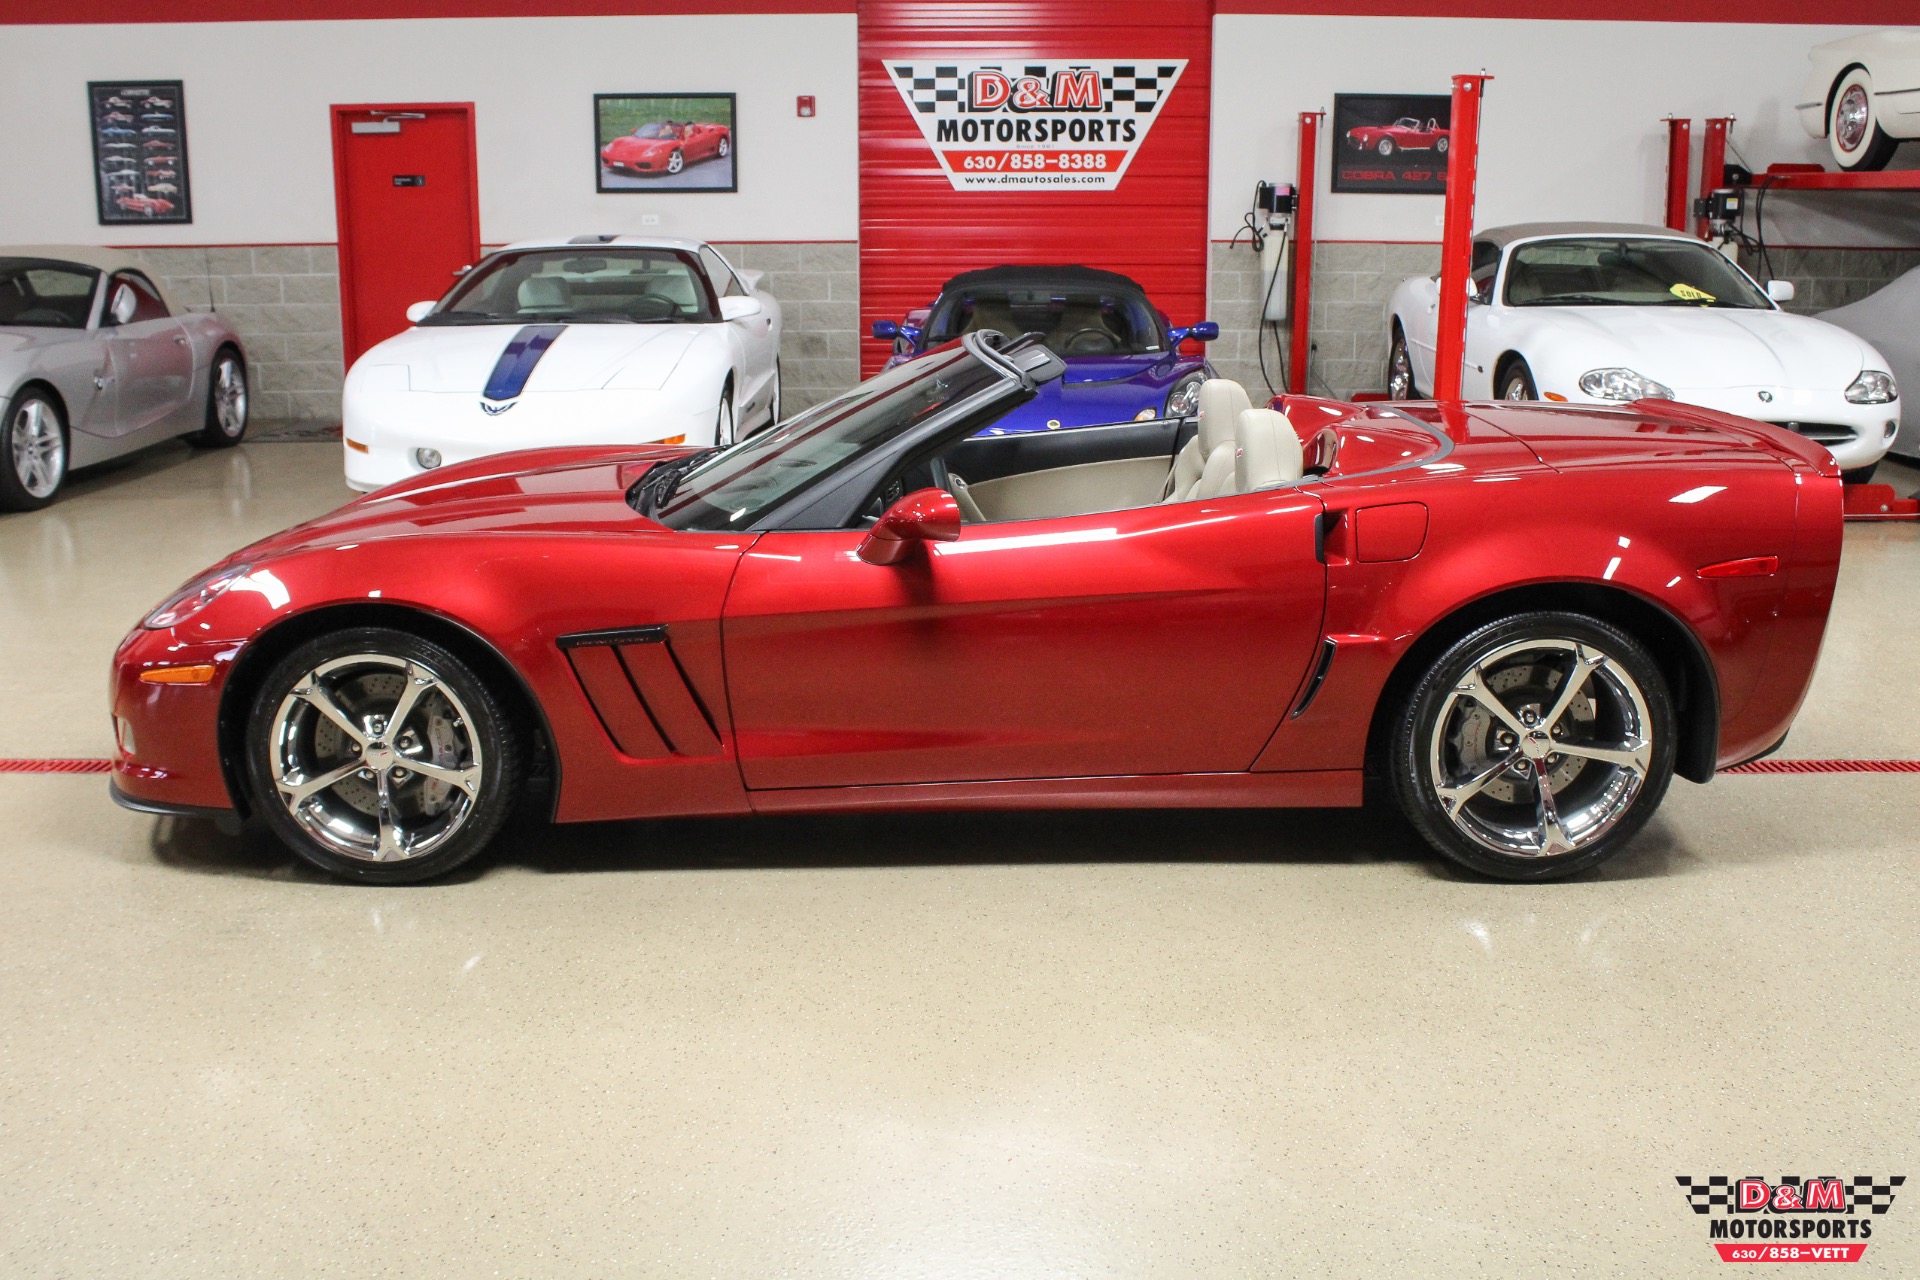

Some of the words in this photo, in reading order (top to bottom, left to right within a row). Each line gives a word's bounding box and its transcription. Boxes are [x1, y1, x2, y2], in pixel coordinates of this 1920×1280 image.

[967, 69, 1103, 112] D&M
[936, 118, 1137, 142] MOTORSPORTS
[963, 152, 1107, 171] 630/858-8388
[964, 174, 1106, 184] www.dmautosales.com
[1342, 171, 1395, 181] COBRA
[1403, 171, 1432, 181] 427
[1680, 290, 1701, 298] SOLD
